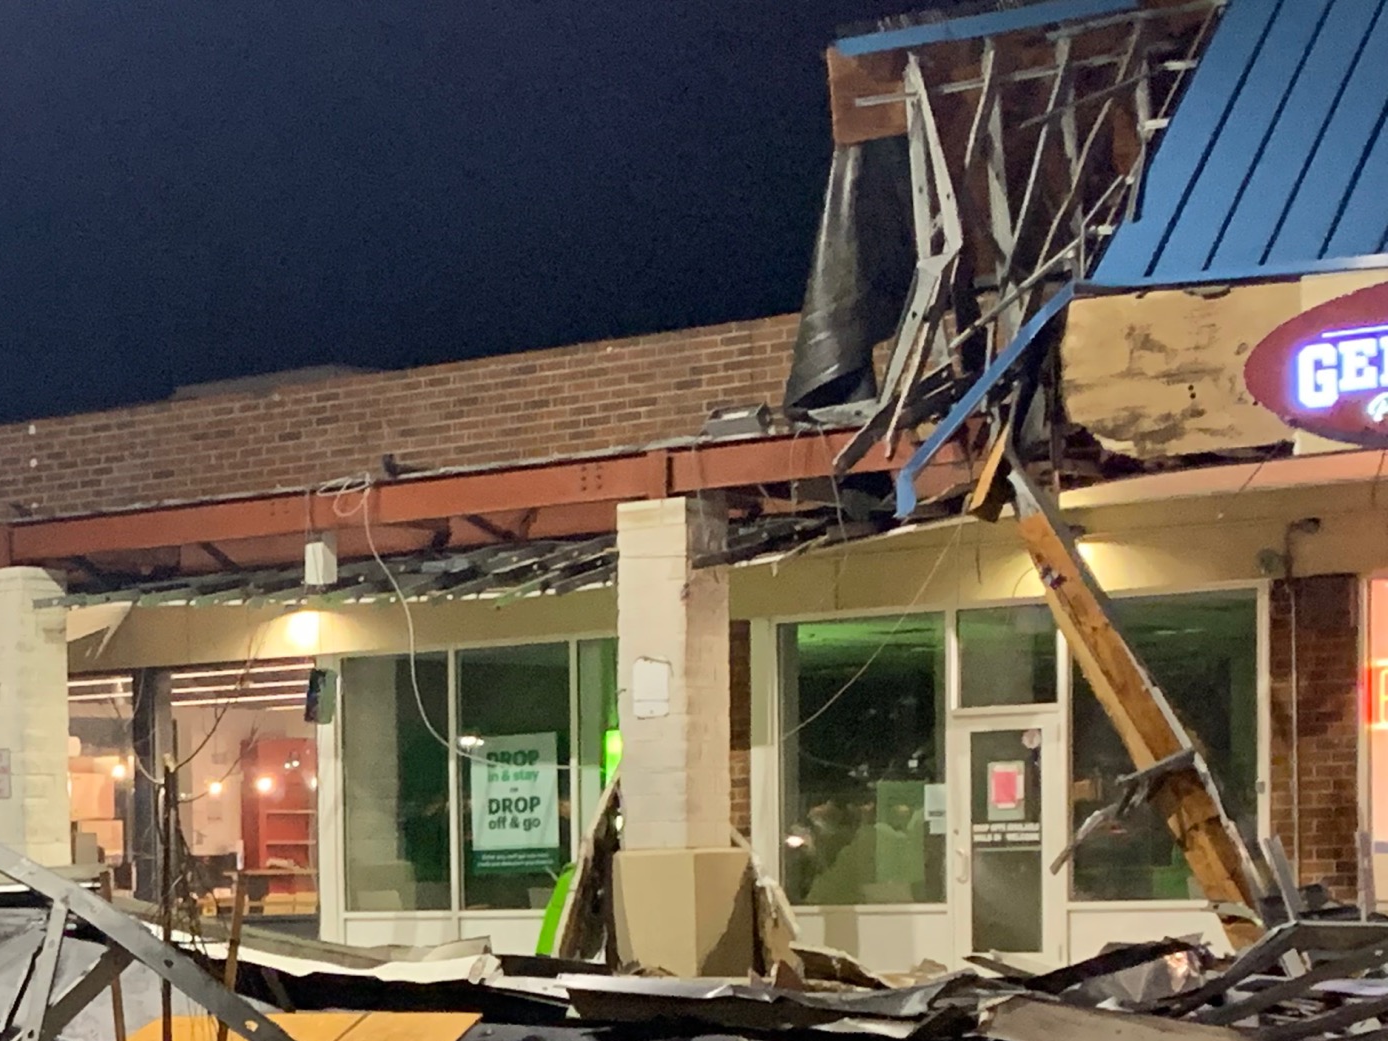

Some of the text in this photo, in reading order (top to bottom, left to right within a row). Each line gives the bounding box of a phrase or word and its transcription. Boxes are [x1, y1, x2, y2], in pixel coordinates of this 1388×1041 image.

[1298, 336, 1388, 409] GE
[487, 750, 540, 769] DROP
[512, 770, 540, 784] stay
[488, 796, 541, 815] DROP
[488, 815, 542, 832] off & go
